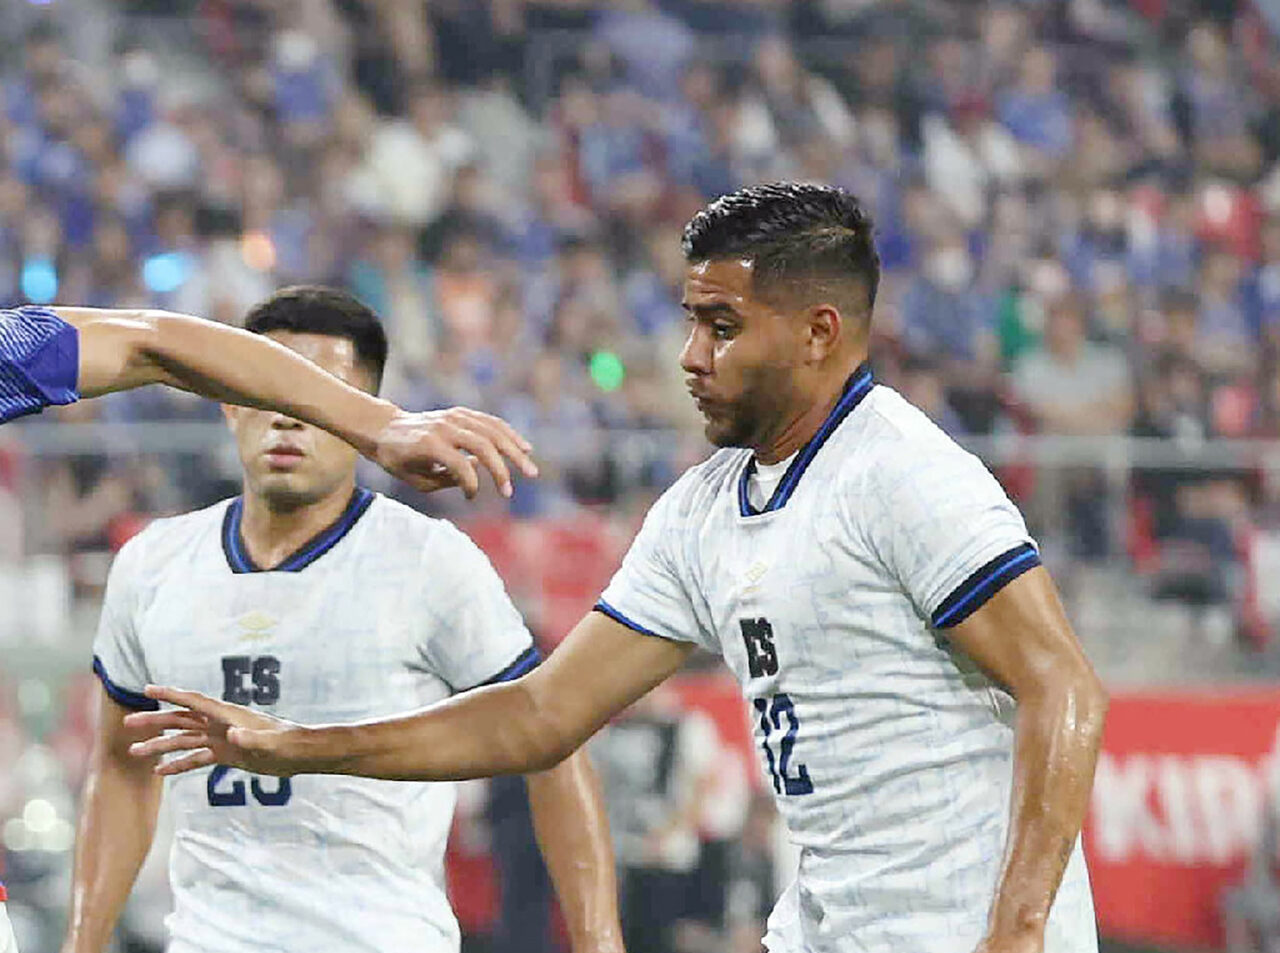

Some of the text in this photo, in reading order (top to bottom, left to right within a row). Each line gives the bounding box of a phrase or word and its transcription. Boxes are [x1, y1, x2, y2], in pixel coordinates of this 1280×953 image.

[739, 617, 780, 679] ES
[222, 655, 280, 705] ES
[753, 693, 815, 796] 12
